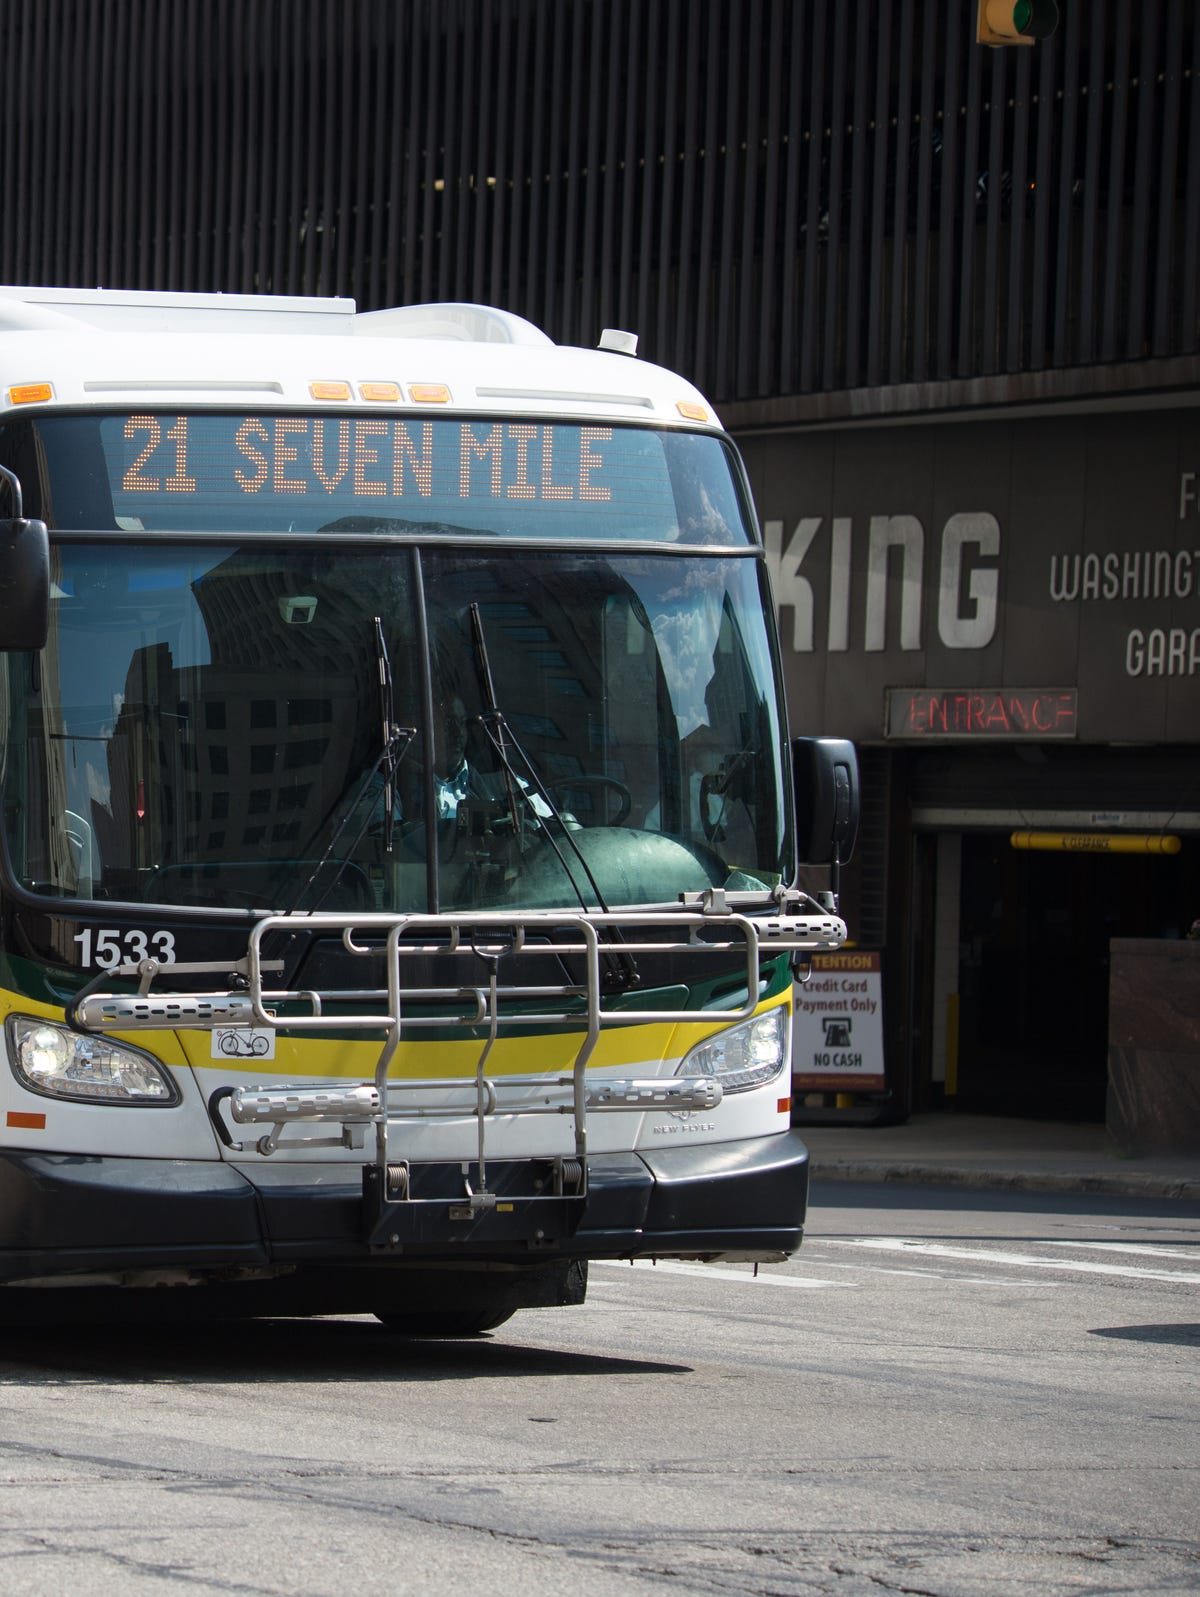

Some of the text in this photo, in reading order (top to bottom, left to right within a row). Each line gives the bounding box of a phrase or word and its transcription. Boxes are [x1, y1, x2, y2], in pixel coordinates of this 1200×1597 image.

[122, 415, 613, 501] 21 SEVEN MILE
[1179, 472, 1200, 519] F
[909, 695, 1074, 731] ENTRANCE
[73, 928, 176, 969] 1533
[800, 955, 872, 969] TENTION
[802, 979, 868, 992] Credit Card
[795, 998, 877, 1016] Payment Only
[814, 1053, 862, 1067] NO CASH
[653, 1123, 715, 1134] NEW FLYER
